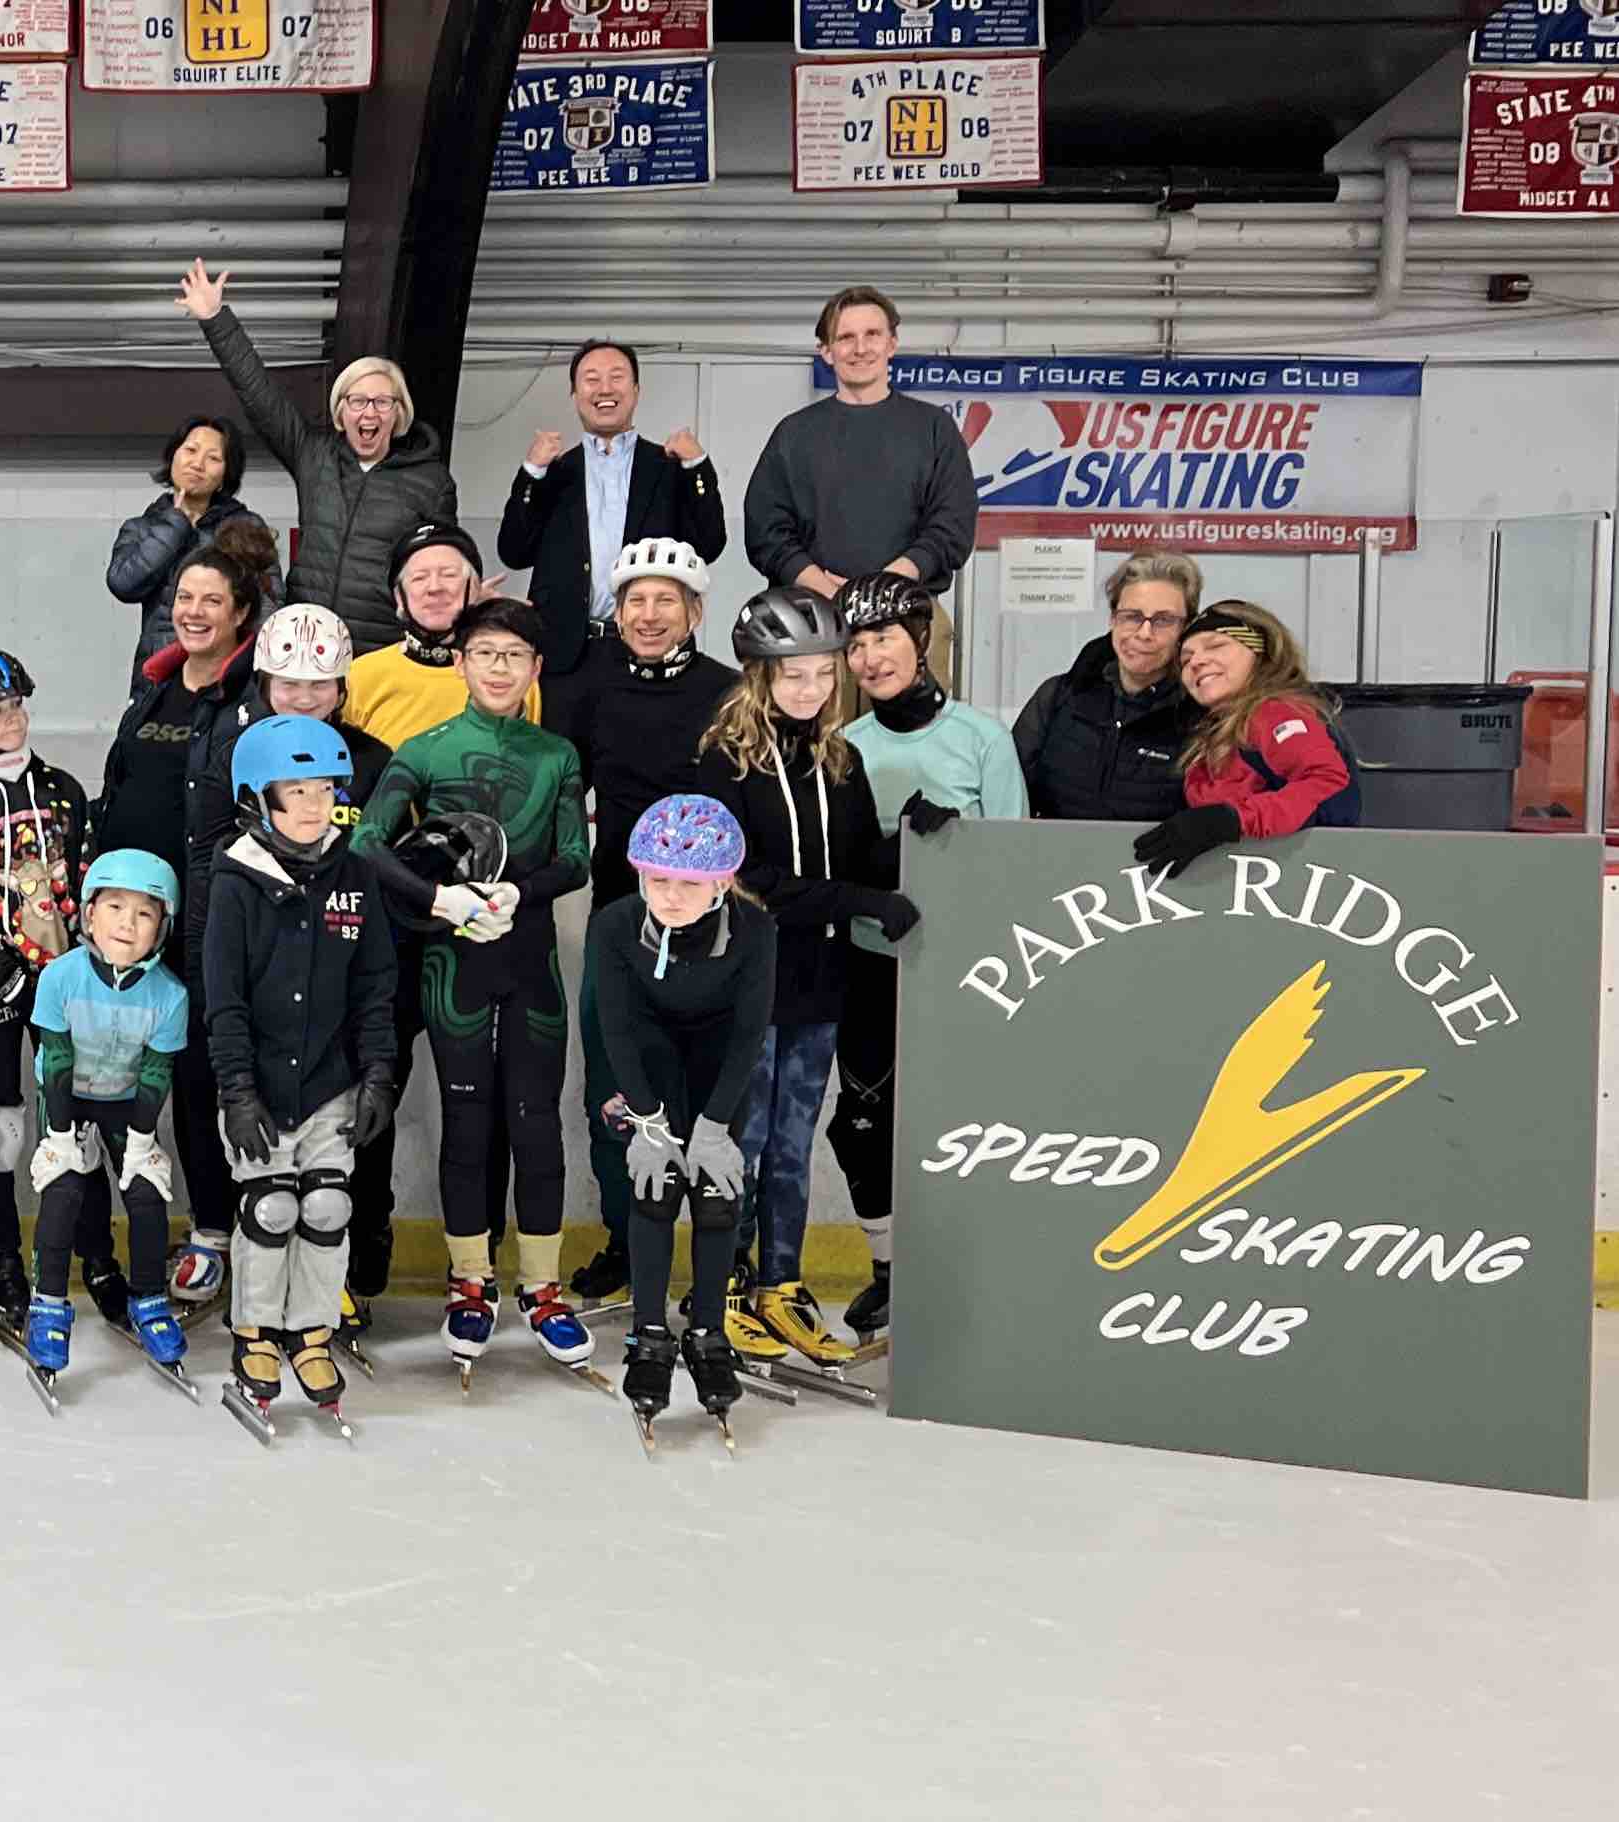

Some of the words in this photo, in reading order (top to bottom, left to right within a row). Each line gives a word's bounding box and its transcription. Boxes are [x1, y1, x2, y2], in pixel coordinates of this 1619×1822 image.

[146, 17, 174, 39] 06
[282, 16, 312, 38] 07
[876, 28, 933, 45] SQUIRT
[951, 28, 961, 43] B
[201, 27, 252, 51] HL
[523, 32, 569, 49] IDGET
[579, 33, 599, 48] AA
[609, 30, 661, 48] MAJOR
[1550, 42, 1584, 57] PEE
[1594, 42, 1619, 58] WE
[173, 67, 226, 83] SQUIRT
[236, 65, 281, 81] ELITE
[851, 70, 887, 98] 4TH
[900, 69, 983, 96] PLACE
[508, 79, 560, 111] ATE
[569, 73, 606, 97] 3RD
[613, 75, 692, 108] PLACE
[897, 102, 937, 123] NI
[1496, 89, 1572, 125] STATE
[1582, 85, 1615, 108] 4TH
[621, 124, 652, 147] 08
[844, 120, 873, 142] 07
[961, 117, 990, 138] 08
[524, 127, 554, 151] 07
[893, 130, 942, 153] HL
[1530, 142, 1560, 164] 08
[538, 169, 569, 186] PEE
[577, 167, 611, 184] WEE
[628, 166, 639, 182] B
[854, 166, 885, 181] PEE
[893, 164, 926, 180] WEE
[940, 162, 980, 178] GOLD
[1519, 190, 1577, 207] MIDGET
[1587, 191, 1610, 206] AA
[888, 366, 1002, 384] HICAGO
[1019, 366, 1125, 385] FIGURE
[1140, 367, 1266, 387] SKATING
[1282, 367, 1358, 386] CLUB
[1066, 451, 1304, 510] SKATING
[326, 891, 363, 912] A&F
[342, 926, 358, 939] 92
[958, 861, 1205, 1021] PARK
[1223, 853, 1523, 1047] RIDGE
[921, 1123, 1160, 1187] SPEED
[1180, 1208, 1531, 1284] SKATING
[1099, 1292, 1308, 1356] CLUB
